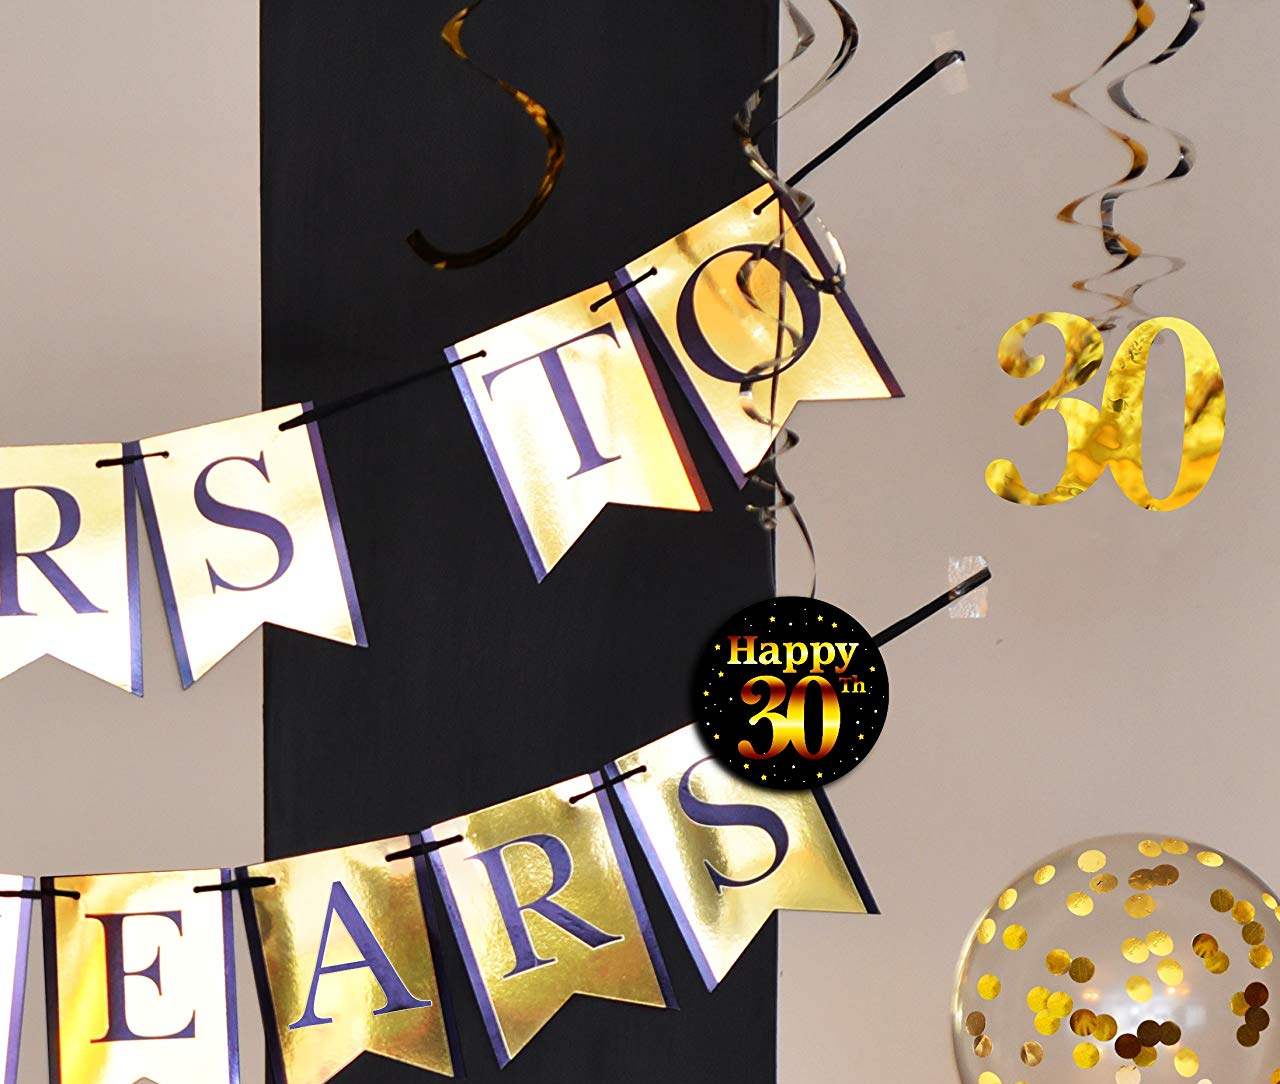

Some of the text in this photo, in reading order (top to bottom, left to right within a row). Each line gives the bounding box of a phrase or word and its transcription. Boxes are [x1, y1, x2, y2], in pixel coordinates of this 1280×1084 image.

[481, 242, 823, 480] TO
[984, 311, 1227, 511] 30
[726, 635, 860, 674] Happy
